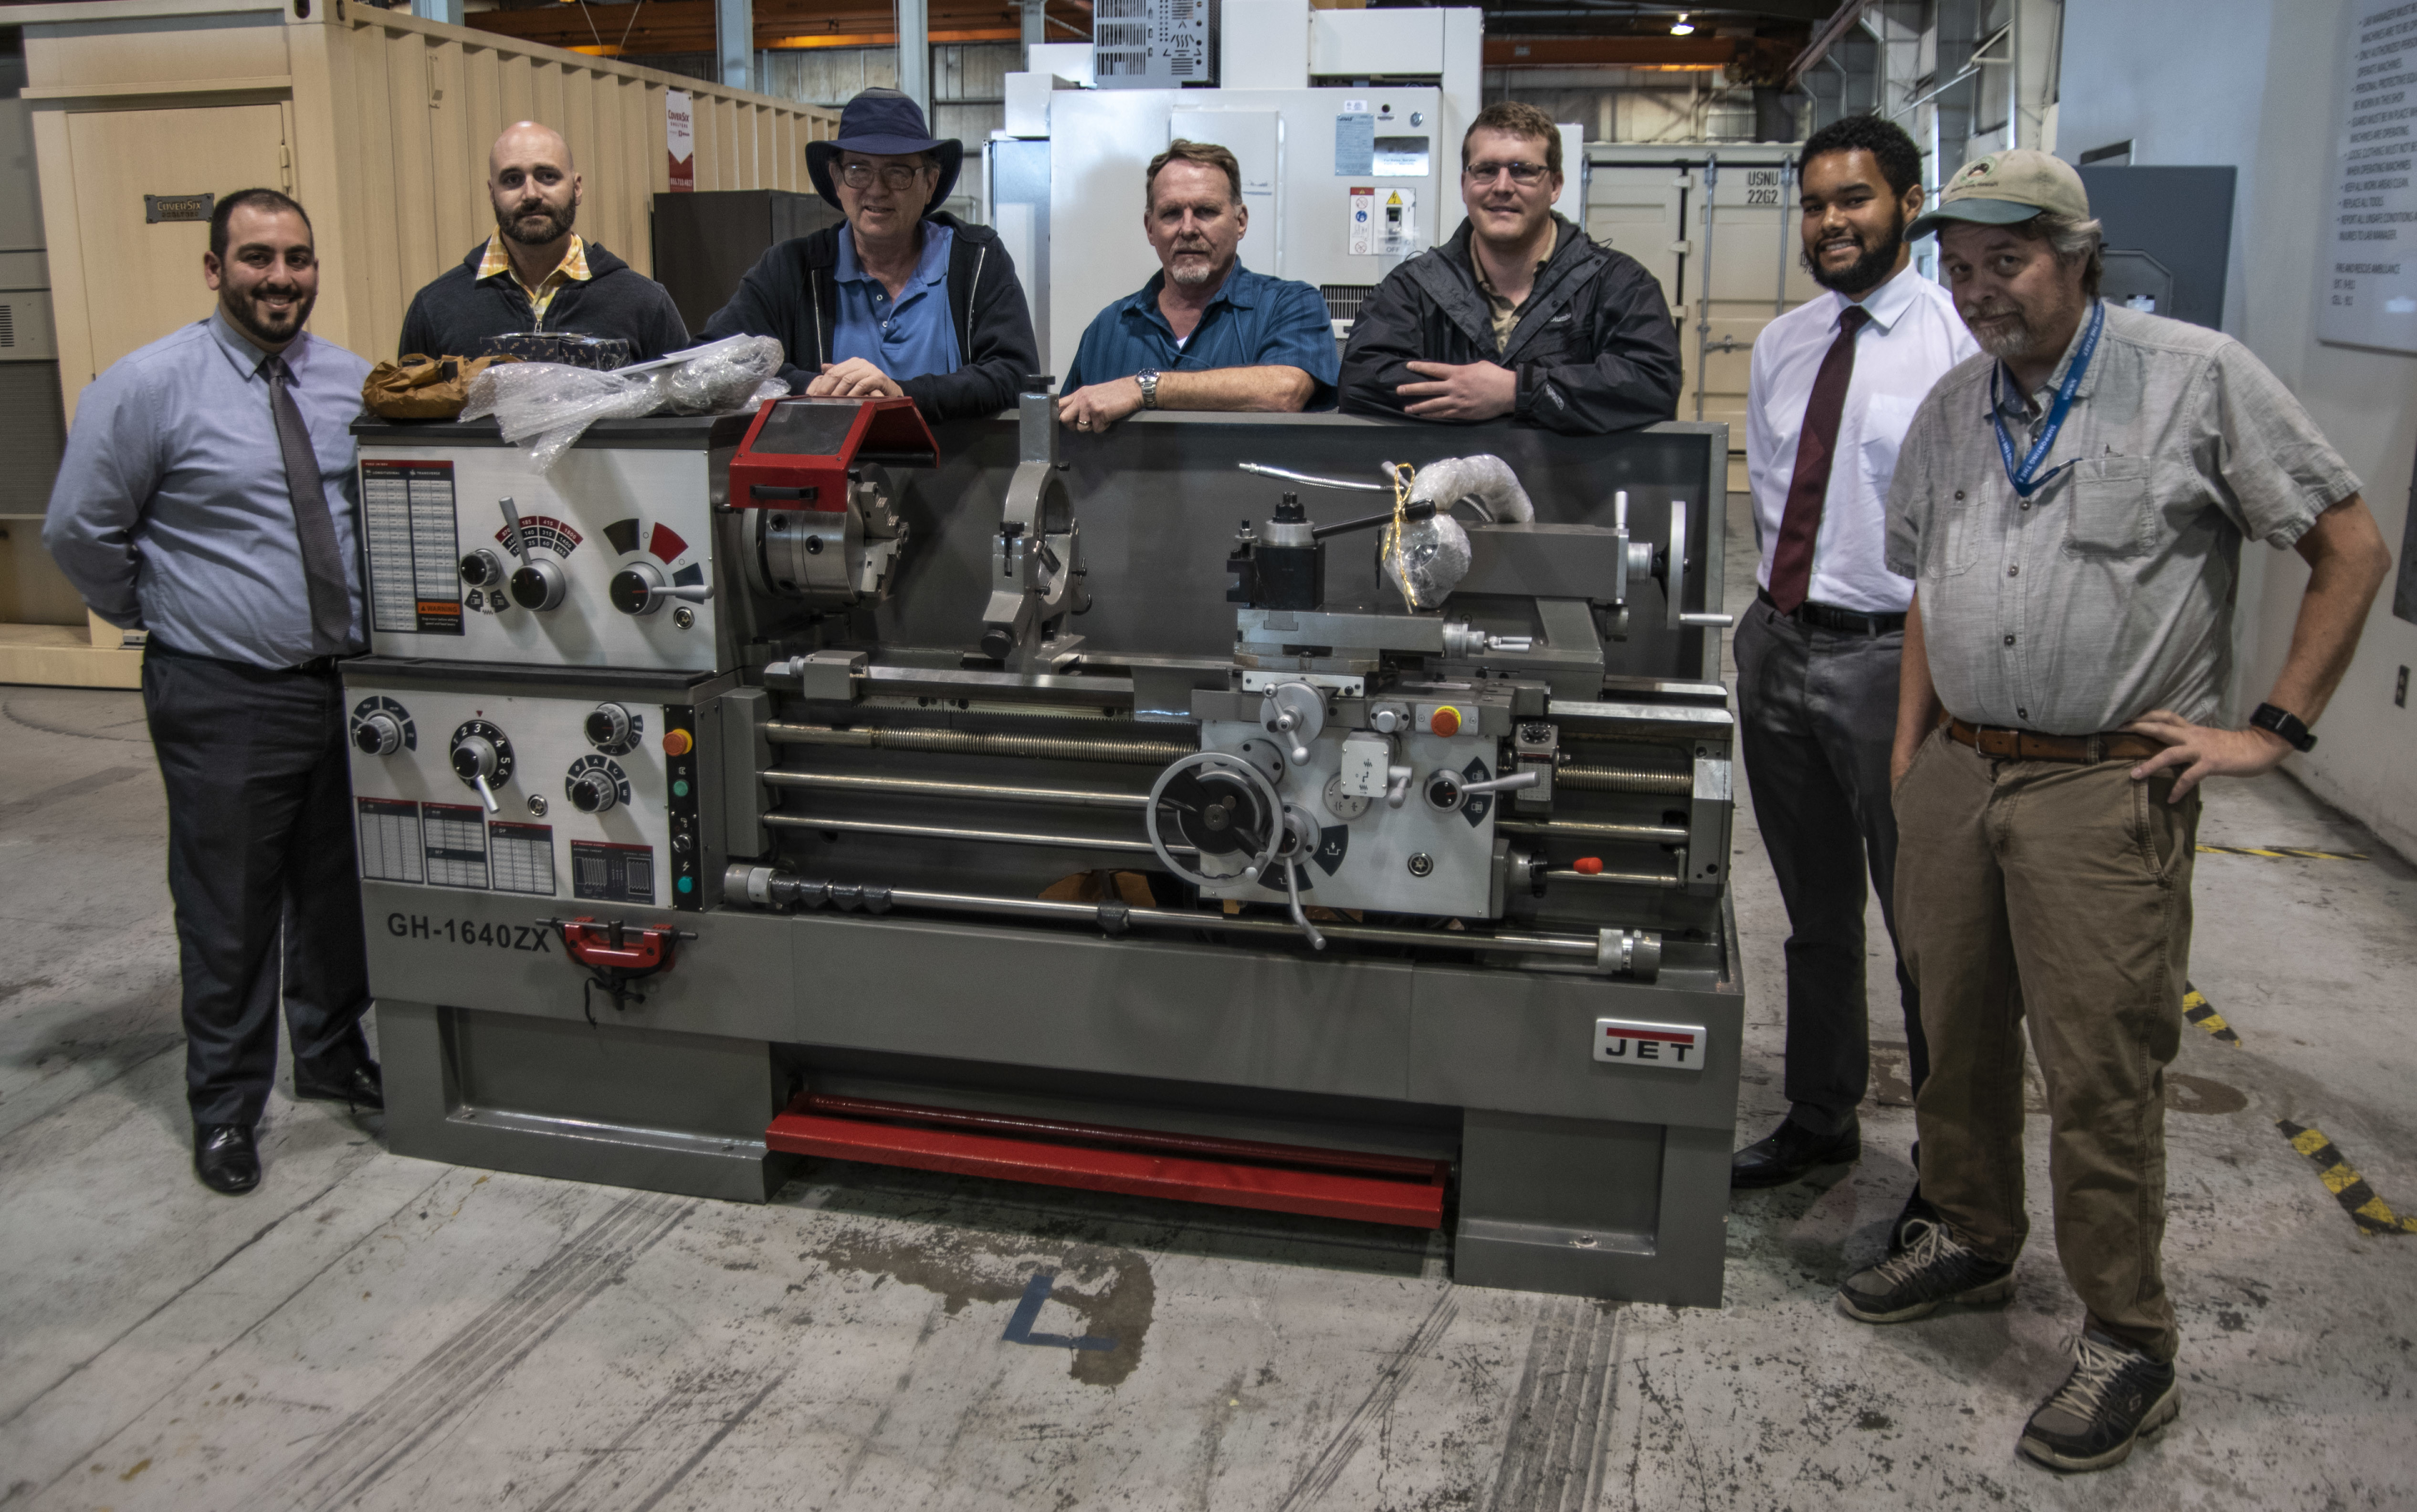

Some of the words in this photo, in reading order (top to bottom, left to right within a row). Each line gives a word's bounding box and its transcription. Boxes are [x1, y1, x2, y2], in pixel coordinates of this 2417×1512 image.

[1748, 171, 1779, 186] USNU
[1748, 189, 1778, 204] 22G2
[2029, 424, 2057, 465] SUPPORTING
[565, 528, 577, 539] 1800
[560, 537, 572, 548] 1400
[556, 546, 566, 555] 265
[462, 726, 468, 736] 2
[474, 724, 481, 733] 3
[388, 912, 550, 953] GH-1640ZX
[1606, 1039, 1694, 1062] JET
